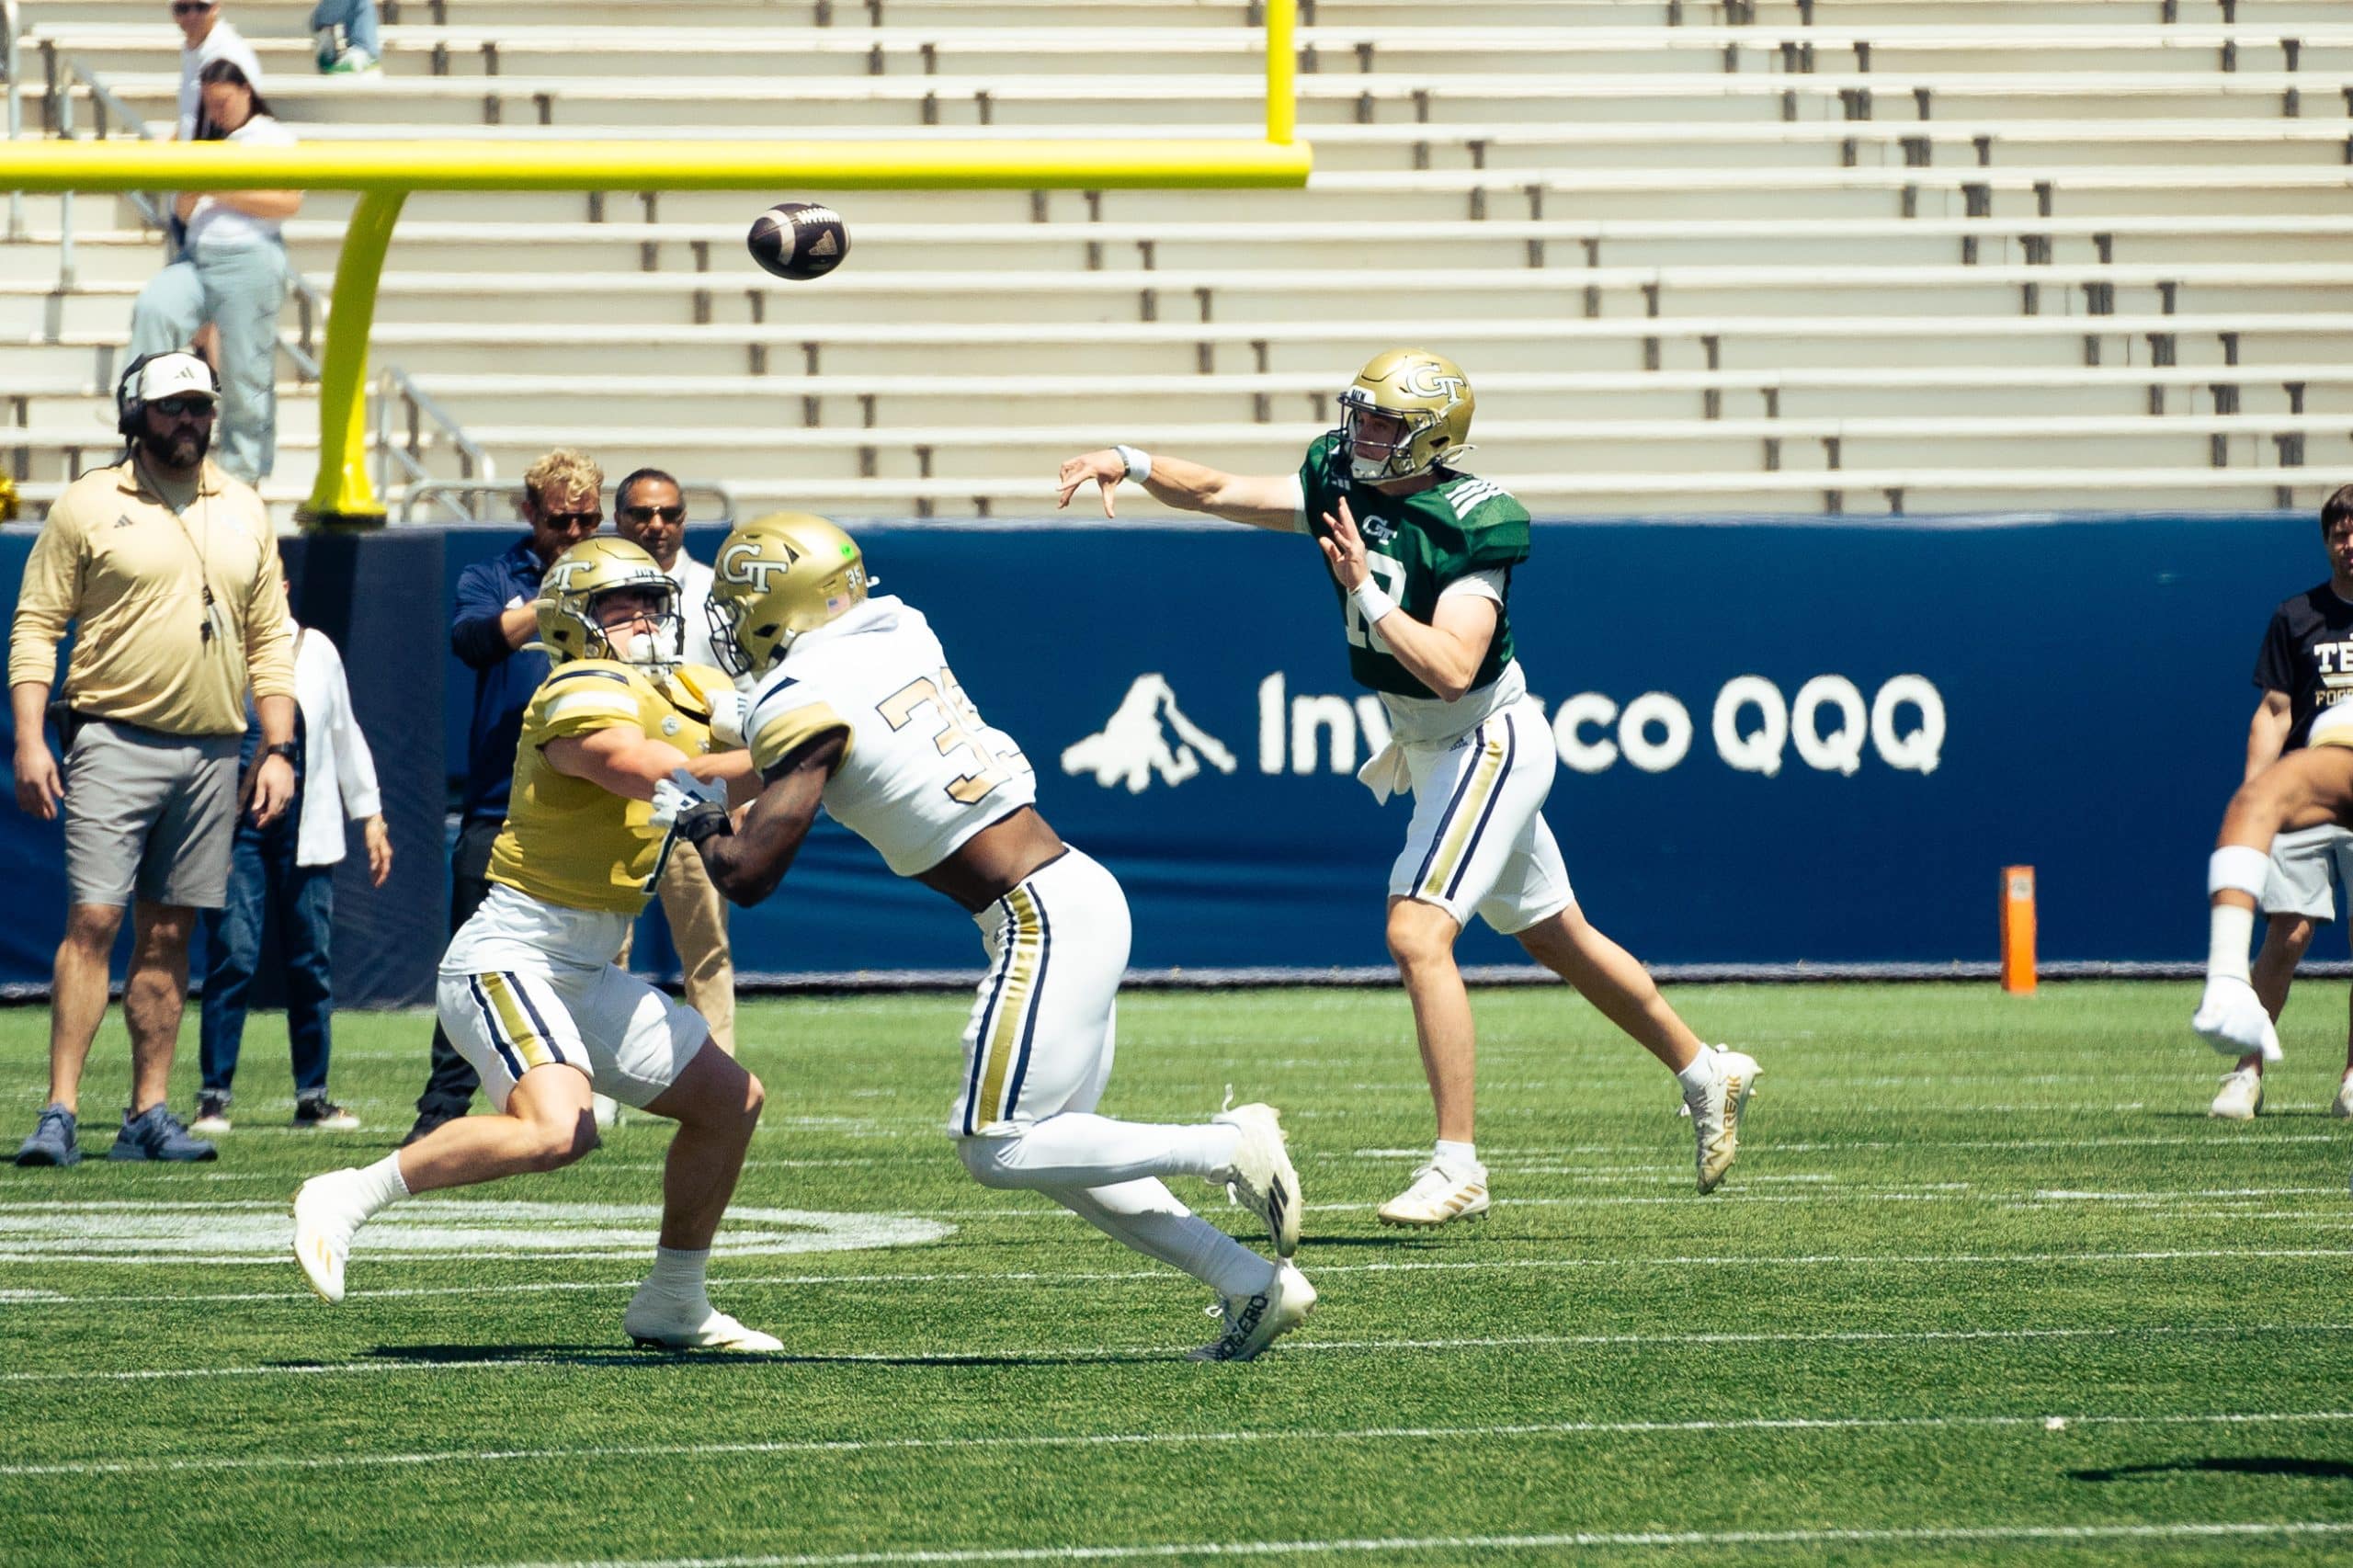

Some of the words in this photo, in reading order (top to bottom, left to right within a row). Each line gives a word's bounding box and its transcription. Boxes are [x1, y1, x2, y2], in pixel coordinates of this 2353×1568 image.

[1405, 361, 1466, 404] GT
[1362, 515, 1397, 545] GT
[722, 542, 789, 594] GT
[1258, 671, 1692, 775] Invco
[1712, 674, 1946, 777] QQQ
